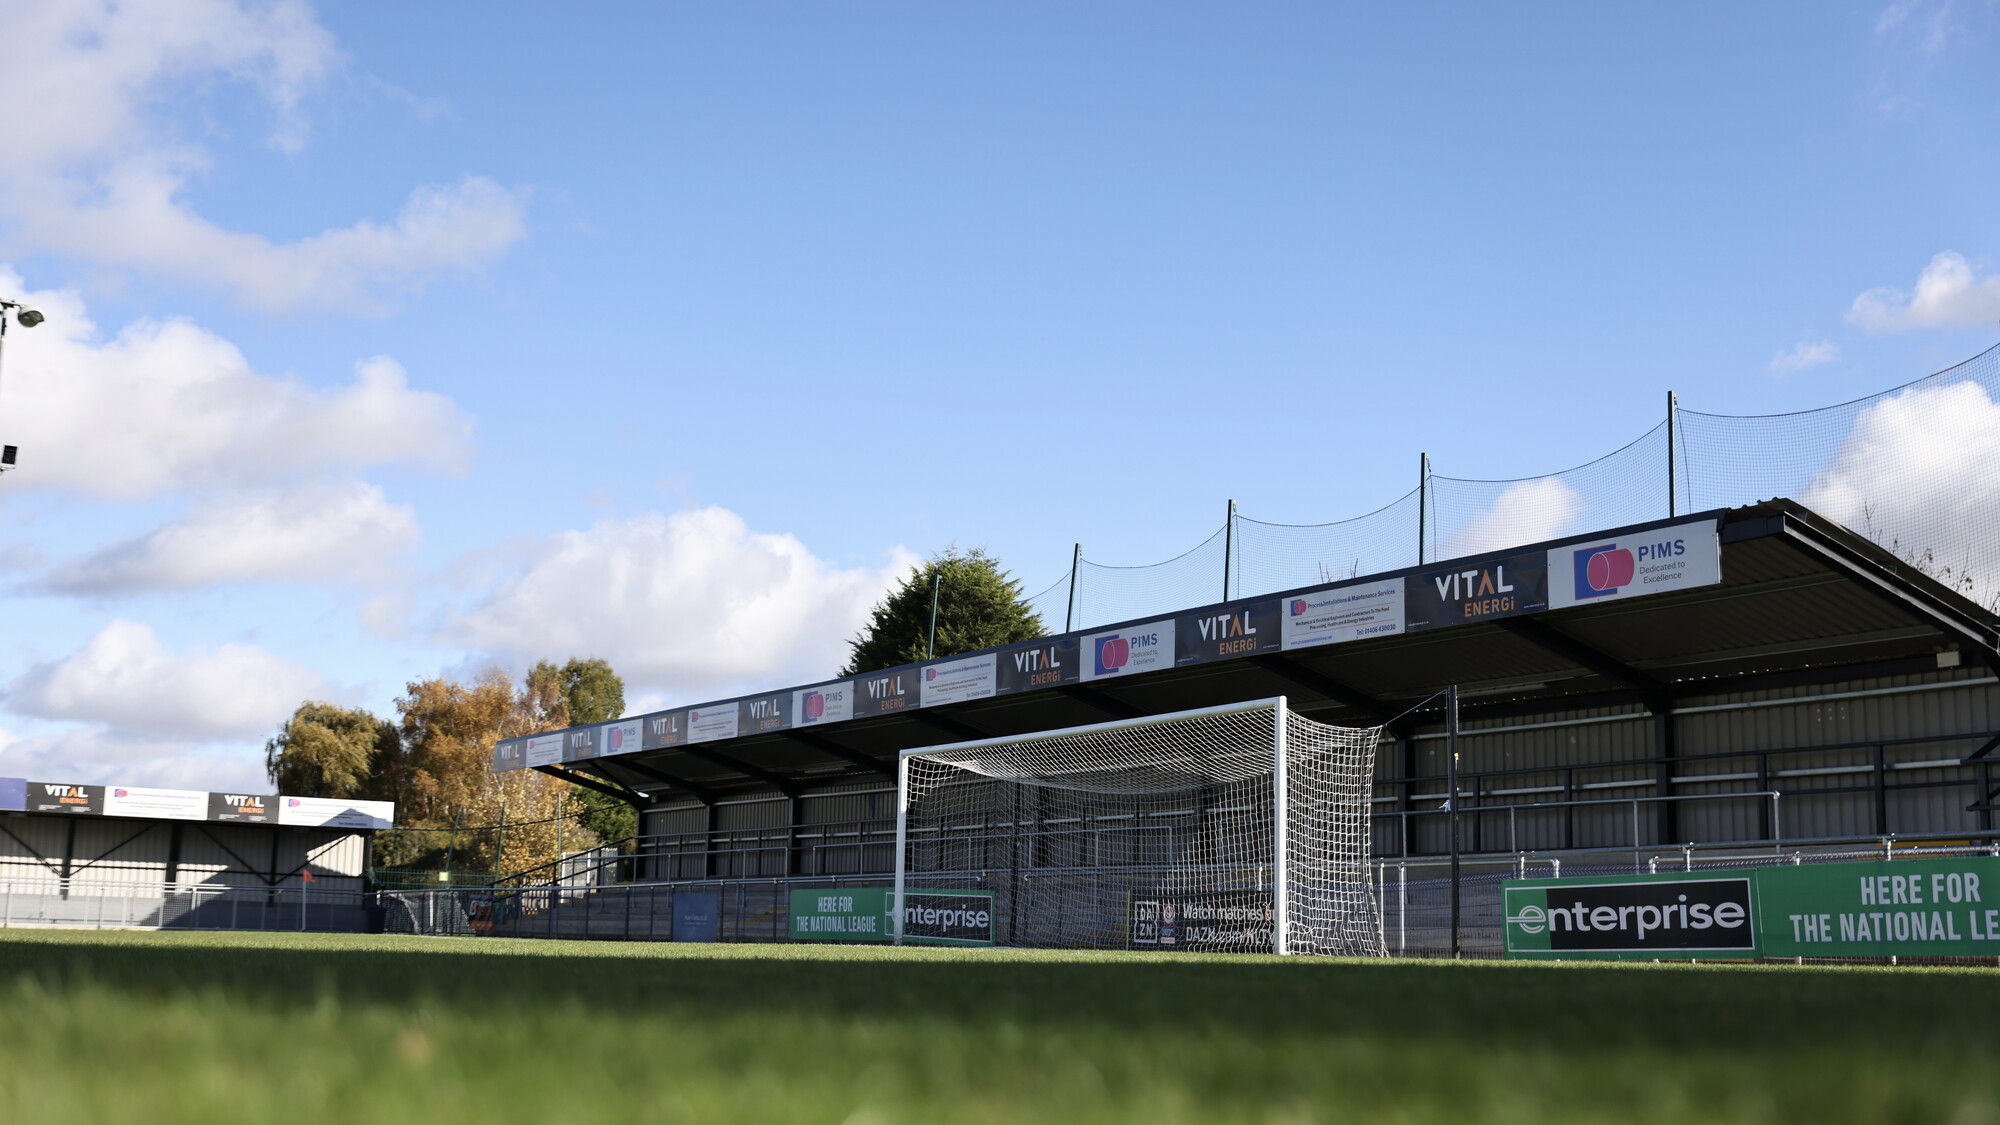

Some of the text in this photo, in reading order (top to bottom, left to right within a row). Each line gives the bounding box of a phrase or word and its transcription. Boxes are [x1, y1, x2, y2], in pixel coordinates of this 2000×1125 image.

[1638, 539, 1685, 561] PIMS
[1640, 561, 1676, 574] Dedicated
[1435, 565, 1513, 601] VITAL
[1643, 573, 1682, 584] Excellence
[1352, 593, 1377, 601] Maintenance
[1378, 589, 1395, 597] Services
[1198, 611, 1256, 641] VITAL
[1131, 633, 1158, 649] PIMS
[1014, 646, 1060, 672] VITAL
[867, 676, 905, 699] VITAL
[825, 691, 843, 703] PIMS
[750, 699, 780, 719] VITAL
[652, 716, 678, 734] VITAL
[45, 785, 89, 798] VITAL
[224, 795, 265, 807] VITAL
[1860, 872, 1981, 905] HERE FOR
[818, 896, 853, 912] HERE FOR
[1184, 904, 1215, 920] Watch
[1217, 906, 1263, 920] matches
[796, 916, 876, 933] THE NATIONAL LEAGUE
[891, 904, 989, 932] nterprise
[1508, 894, 1746, 940] enterprise
[1789, 914, 1832, 942] THE
[1839, 911, 1961, 942] NATIONAL
